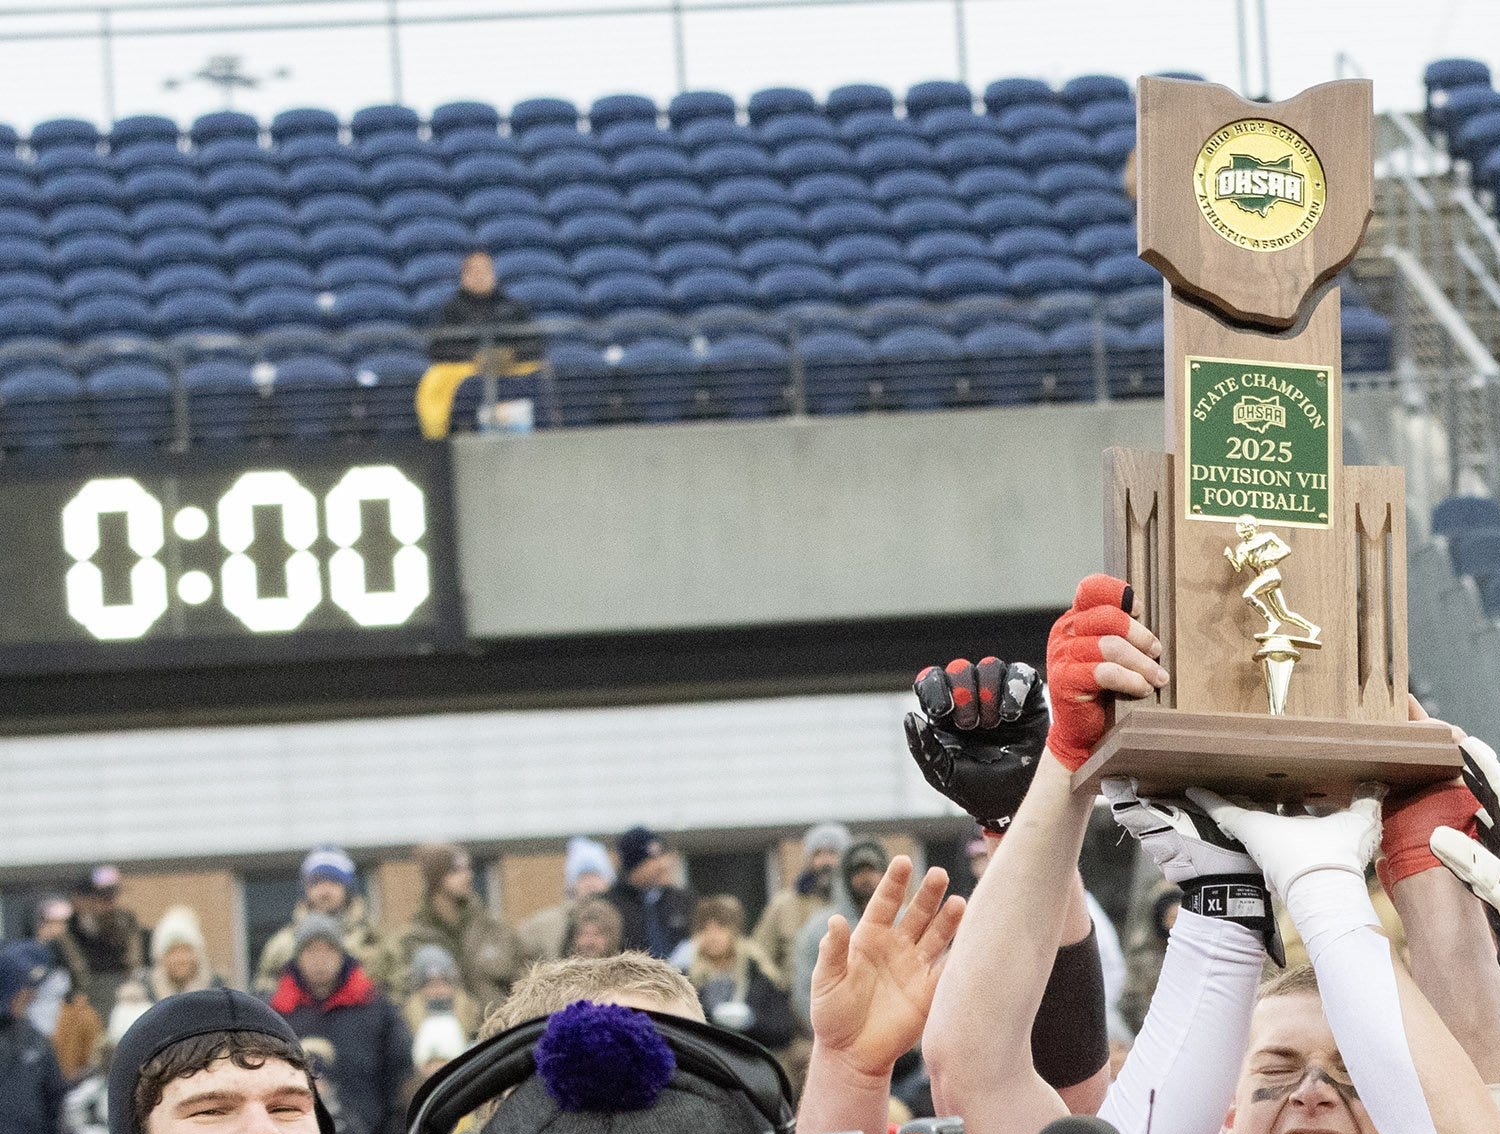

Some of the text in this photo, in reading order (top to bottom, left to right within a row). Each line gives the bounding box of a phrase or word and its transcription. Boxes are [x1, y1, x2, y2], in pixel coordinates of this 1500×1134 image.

[1205, 122, 1315, 163] OHIO HIGH SCHOOL
[1219, 169, 1302, 203] OHSAA
[1198, 194, 1320, 249] ATHLETIC ASSOCIATION
[1193, 373, 1326, 430] STATE CHAMPION
[1237, 406, 1282, 423] OHSAA
[1226, 436, 1293, 463] 2025
[1192, 464, 1328, 490] DIVISION VII
[1203, 487, 1316, 513] FOOTBALL
[62, 465, 430, 640] 0:00
[1207, 898, 1223, 911] XL
